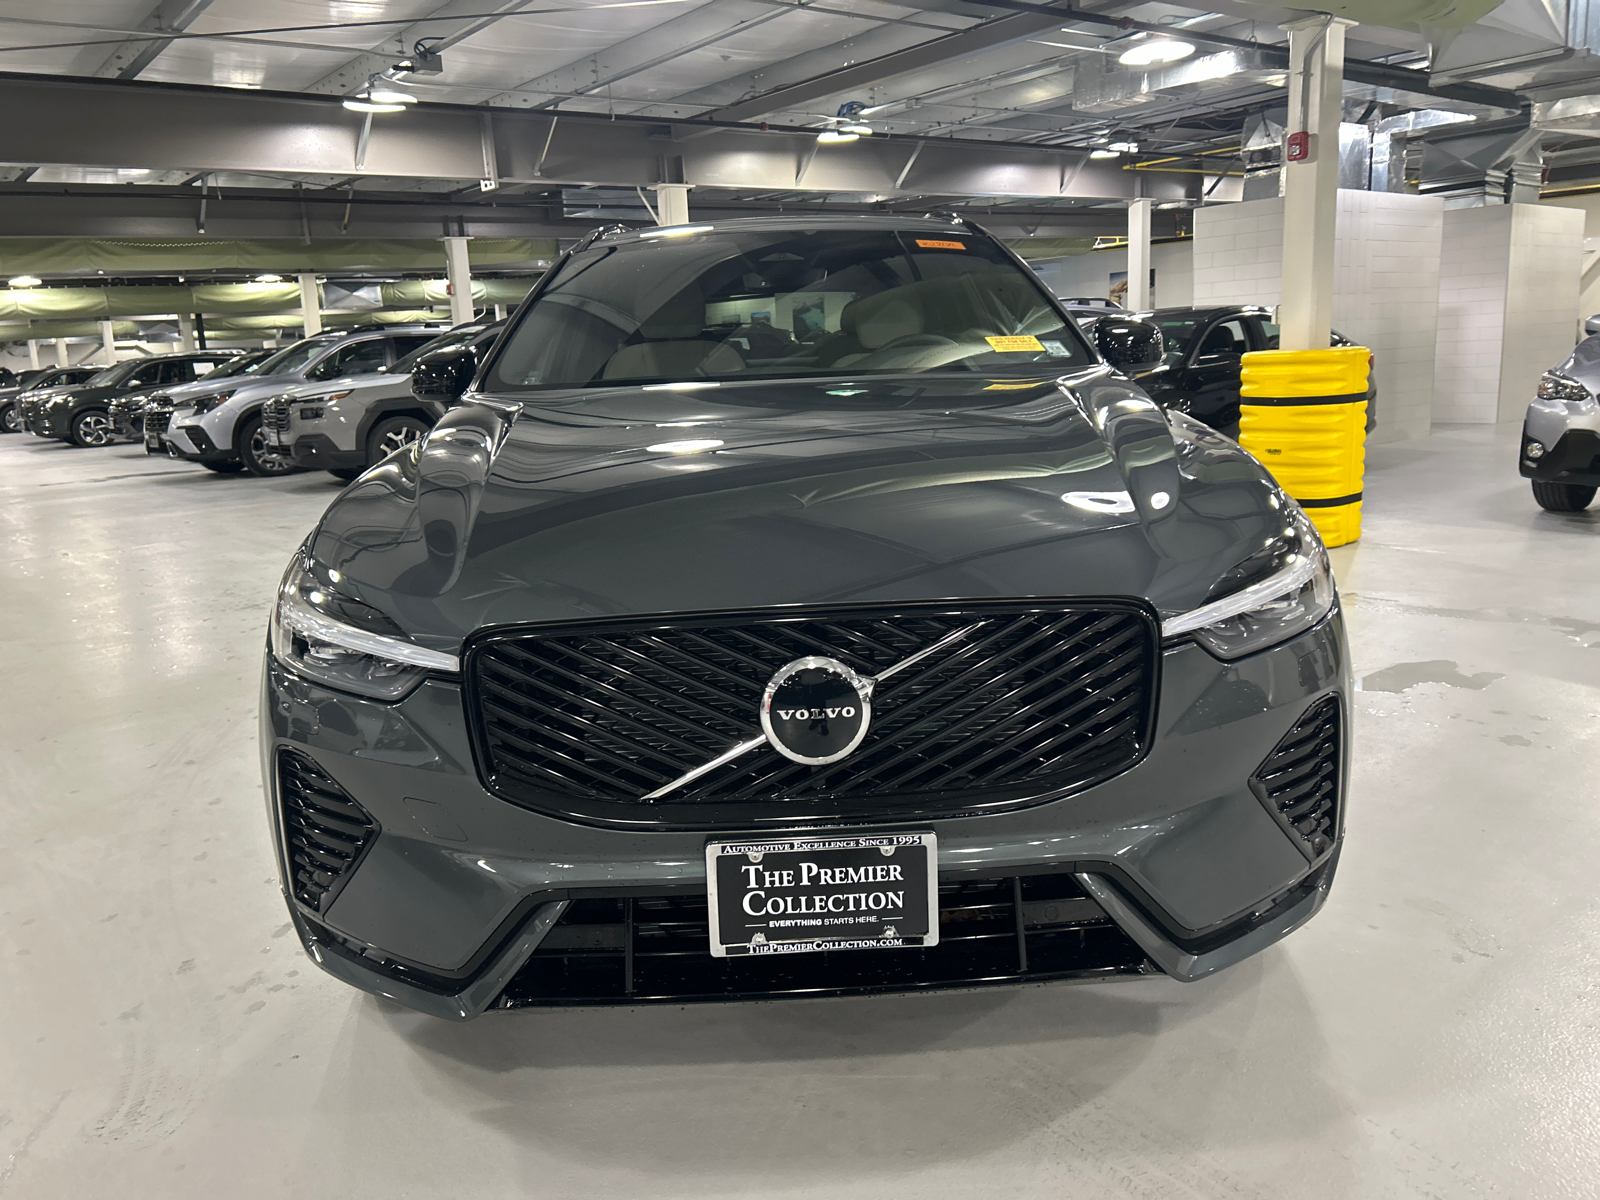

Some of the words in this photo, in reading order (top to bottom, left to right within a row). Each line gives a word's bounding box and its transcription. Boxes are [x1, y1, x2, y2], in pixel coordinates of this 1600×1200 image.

[776, 706, 856, 720] VOLVO
[723, 843, 791, 854] AUTOMOTIVE
[793, 840, 857, 850] EXCELLENCE
[858, 838, 889, 847] SINCE
[892, 836, 921, 845] 1995
[741, 864, 796, 889] THE
[799, 862, 904, 886] PREMIER
[742, 890, 905, 916] COLLECTION
[769, 918, 822, 928] EVERYTHING
[824, 917, 854, 925] STARTS
